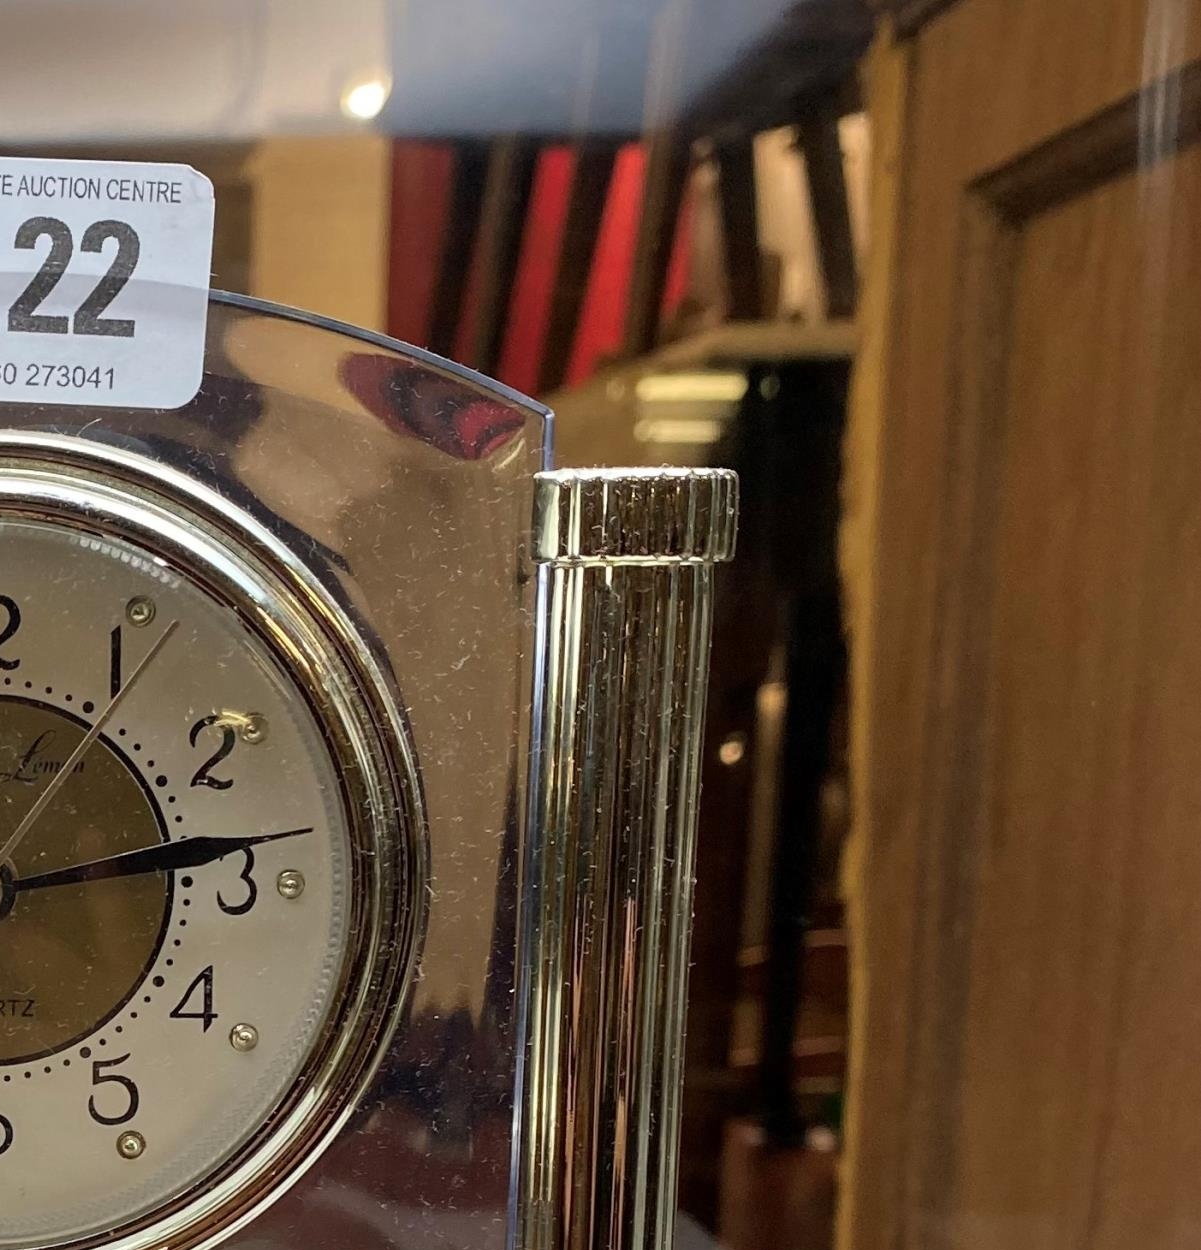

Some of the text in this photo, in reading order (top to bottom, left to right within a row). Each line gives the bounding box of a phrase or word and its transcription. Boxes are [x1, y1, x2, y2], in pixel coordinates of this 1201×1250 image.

[17, 175, 101, 200] AUCTION
[106, 178, 183, 204] CENTRE
[25, 364, 114, 390] 273041
[110, 625, 122, 700] 1
[188, 715, 237, 791] 2
[216, 844, 258, 916] 3
[169, 964, 219, 1033] 4
[87, 1053, 141, 1126] 5
